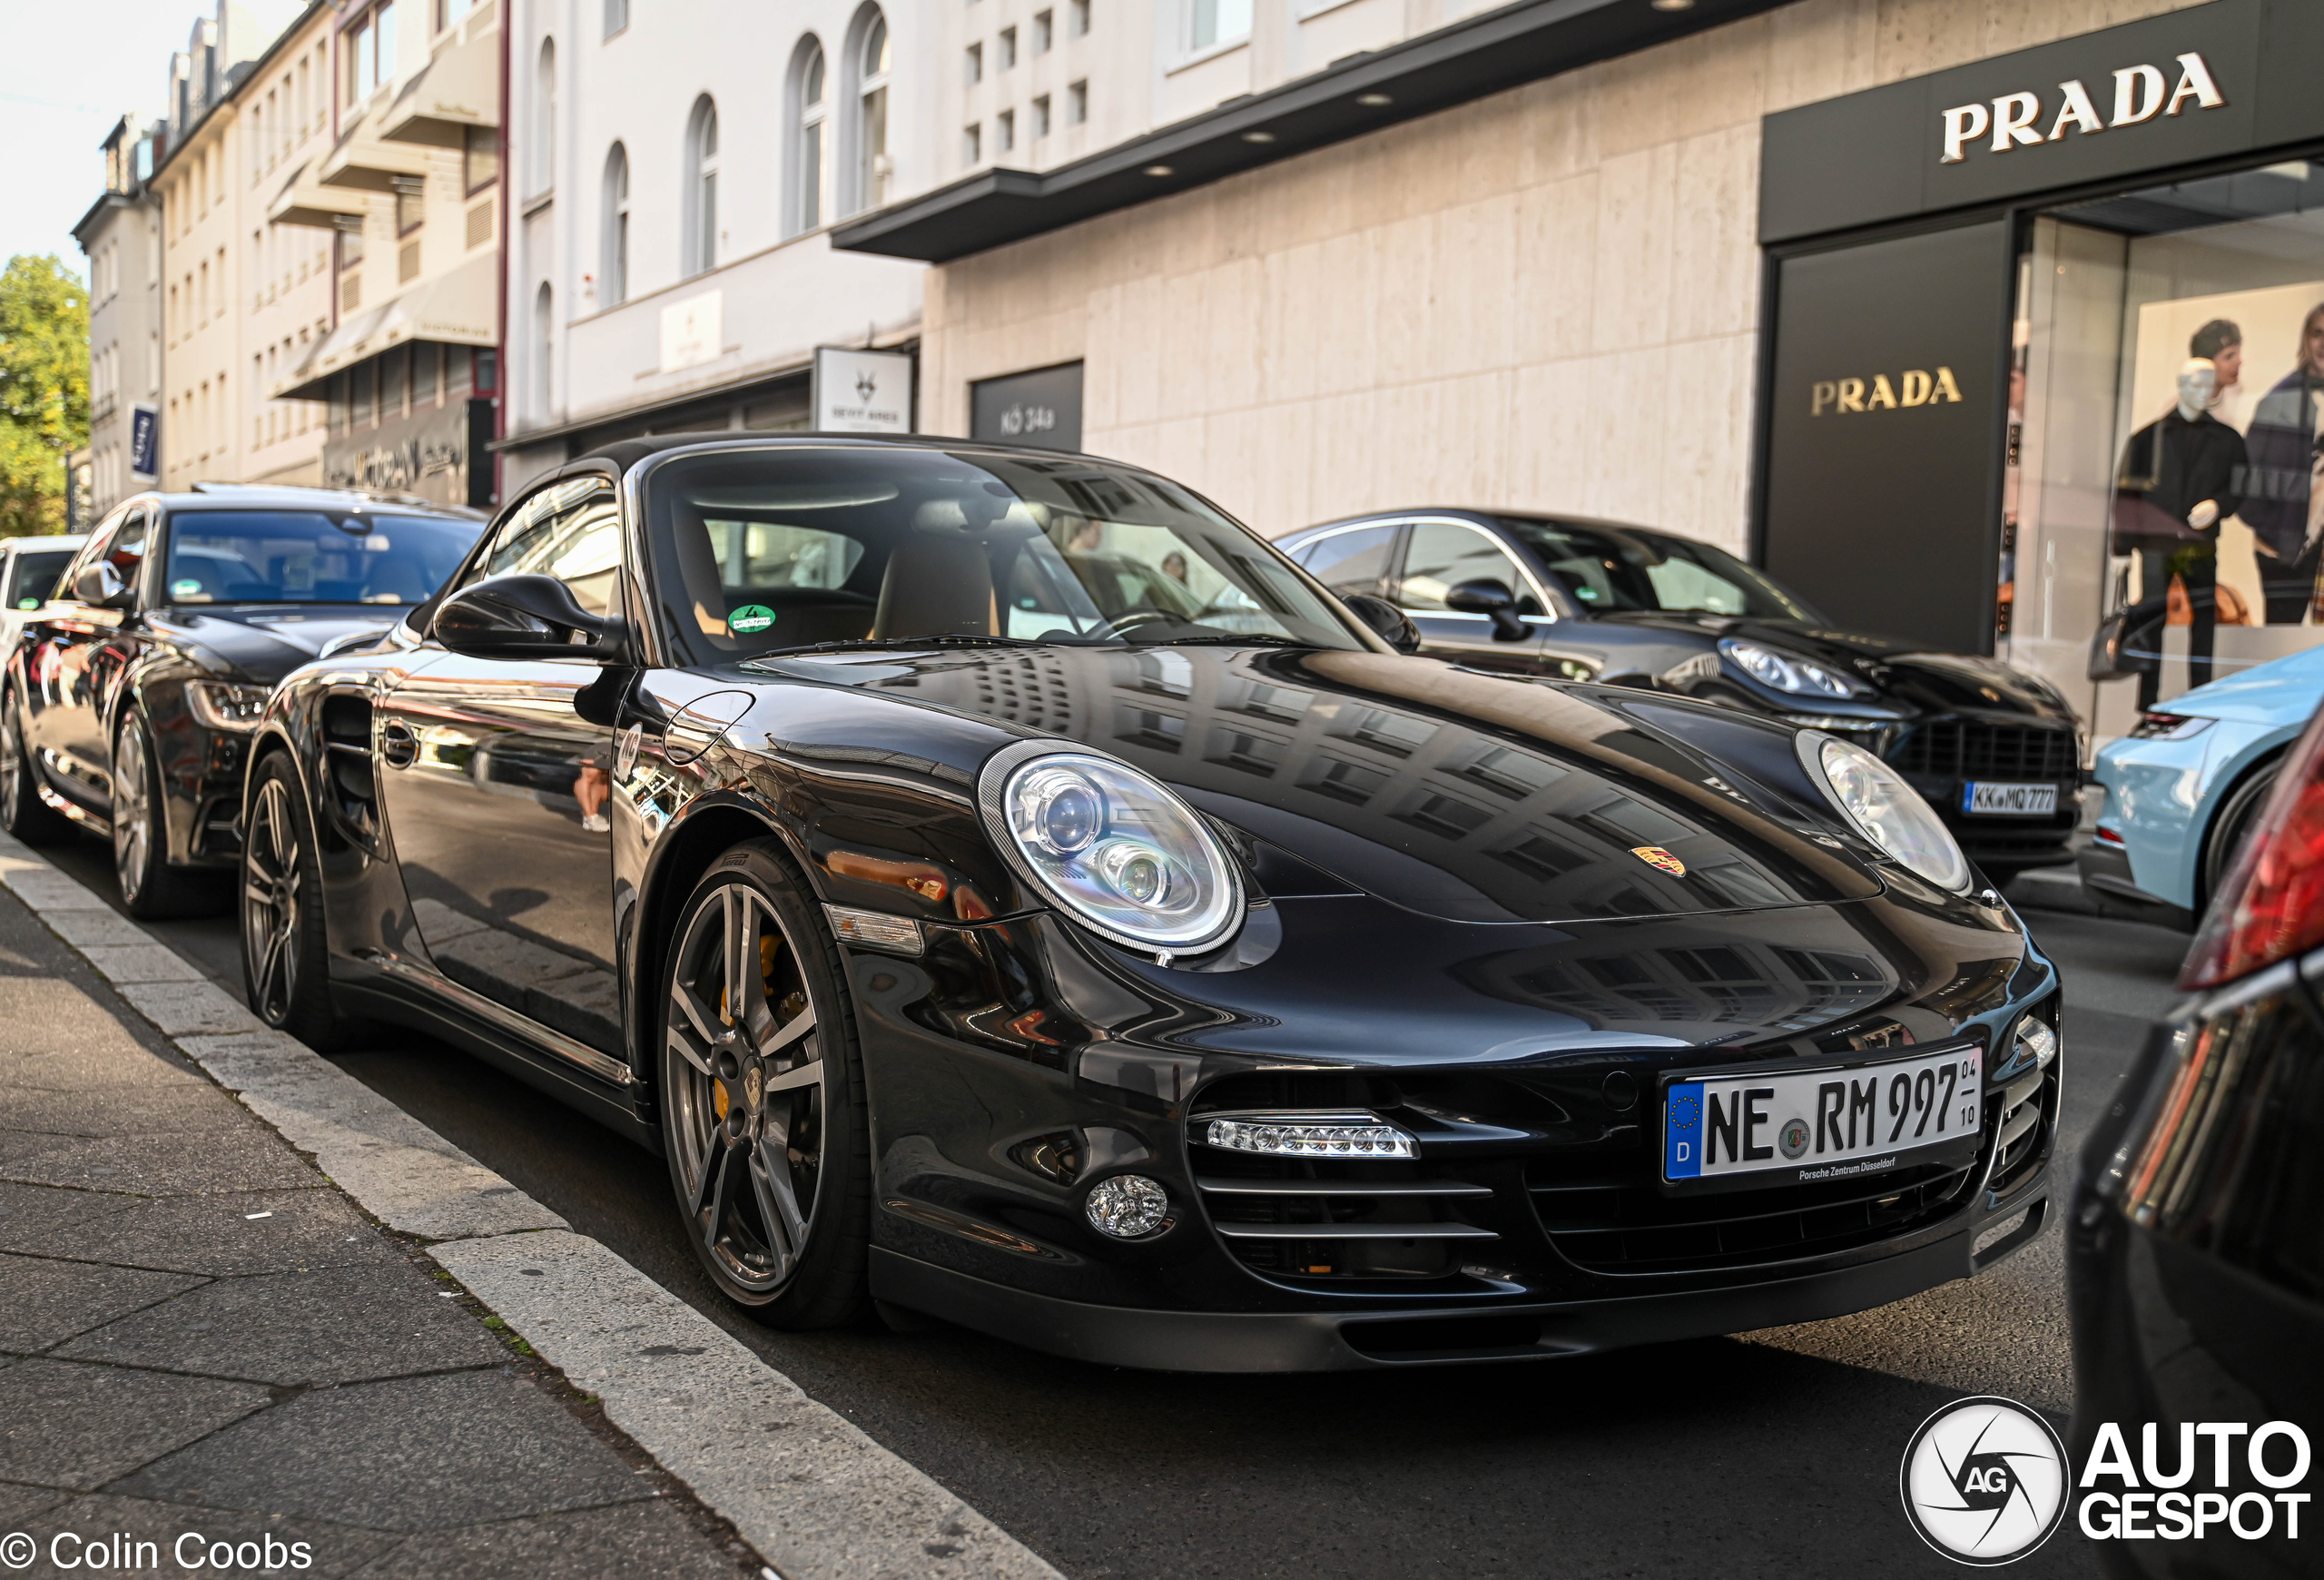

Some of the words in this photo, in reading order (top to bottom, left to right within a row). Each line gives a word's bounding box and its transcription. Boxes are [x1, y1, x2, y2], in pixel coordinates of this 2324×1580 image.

[1939, 52, 2227, 164] PRADA
[1811, 366, 1964, 416] PRADA
[744, 606, 759, 618] 4
[1974, 786, 1996, 808] KK
[2004, 788, 2025, 809] MQ
[2028, 788, 2054, 809] 777
[1962, 1059, 1975, 1079] 04
[1707, 1088, 1773, 1164] NE
[1816, 1077, 1877, 1153] RM
[1889, 1063, 1957, 1142] 997
[1961, 1105, 1974, 1126] 10
[1678, 1141, 1689, 1162] D
[1799, 1169, 1829, 1180] Porsche
[1830, 1165, 1859, 1176] Zentrum
[1861, 1157, 1896, 1171] Düsseldorf
